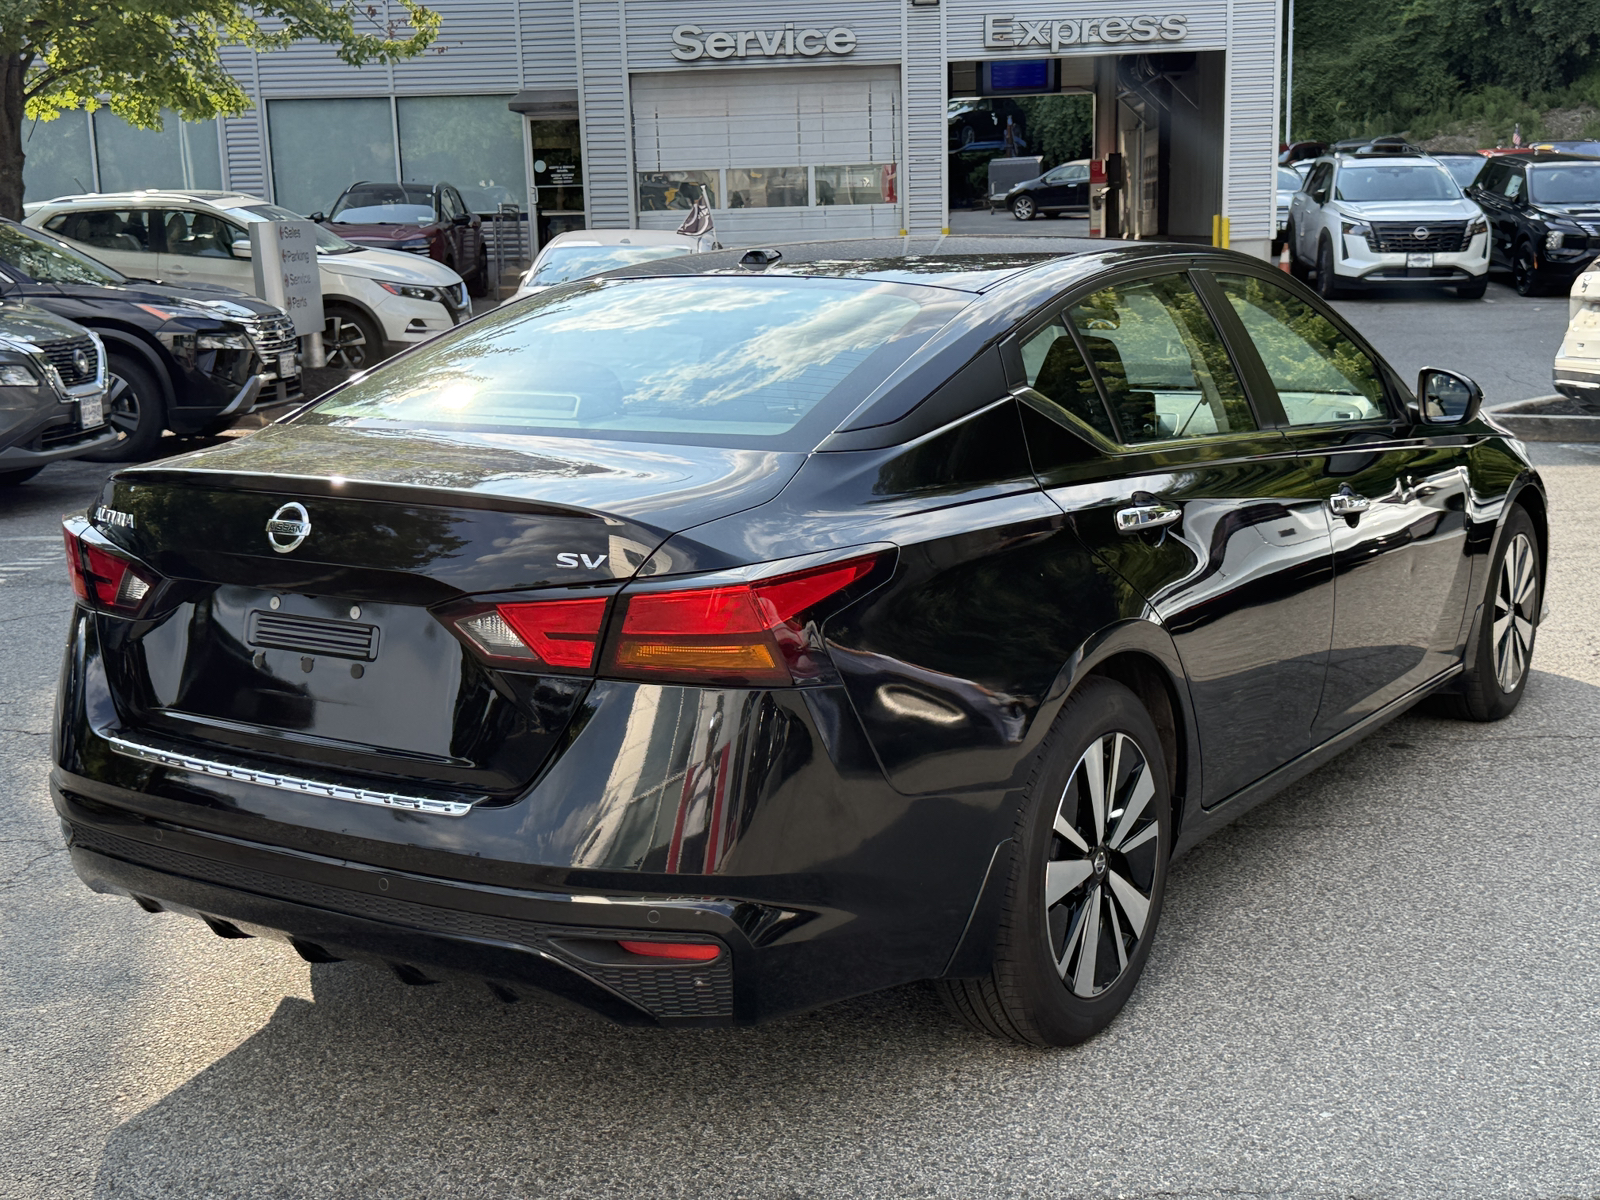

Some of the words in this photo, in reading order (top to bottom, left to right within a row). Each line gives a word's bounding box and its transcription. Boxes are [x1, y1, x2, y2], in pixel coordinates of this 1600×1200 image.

[983, 14, 1188, 54] Express
[670, 22, 857, 61] Service
[284, 226, 301, 239] Sales
[287, 251, 310, 264] Parking
[289, 273, 312, 286] Service
[291, 296, 308, 309] Parts
[270, 520, 304, 534] NISSAN
[556, 552, 608, 570] SV
